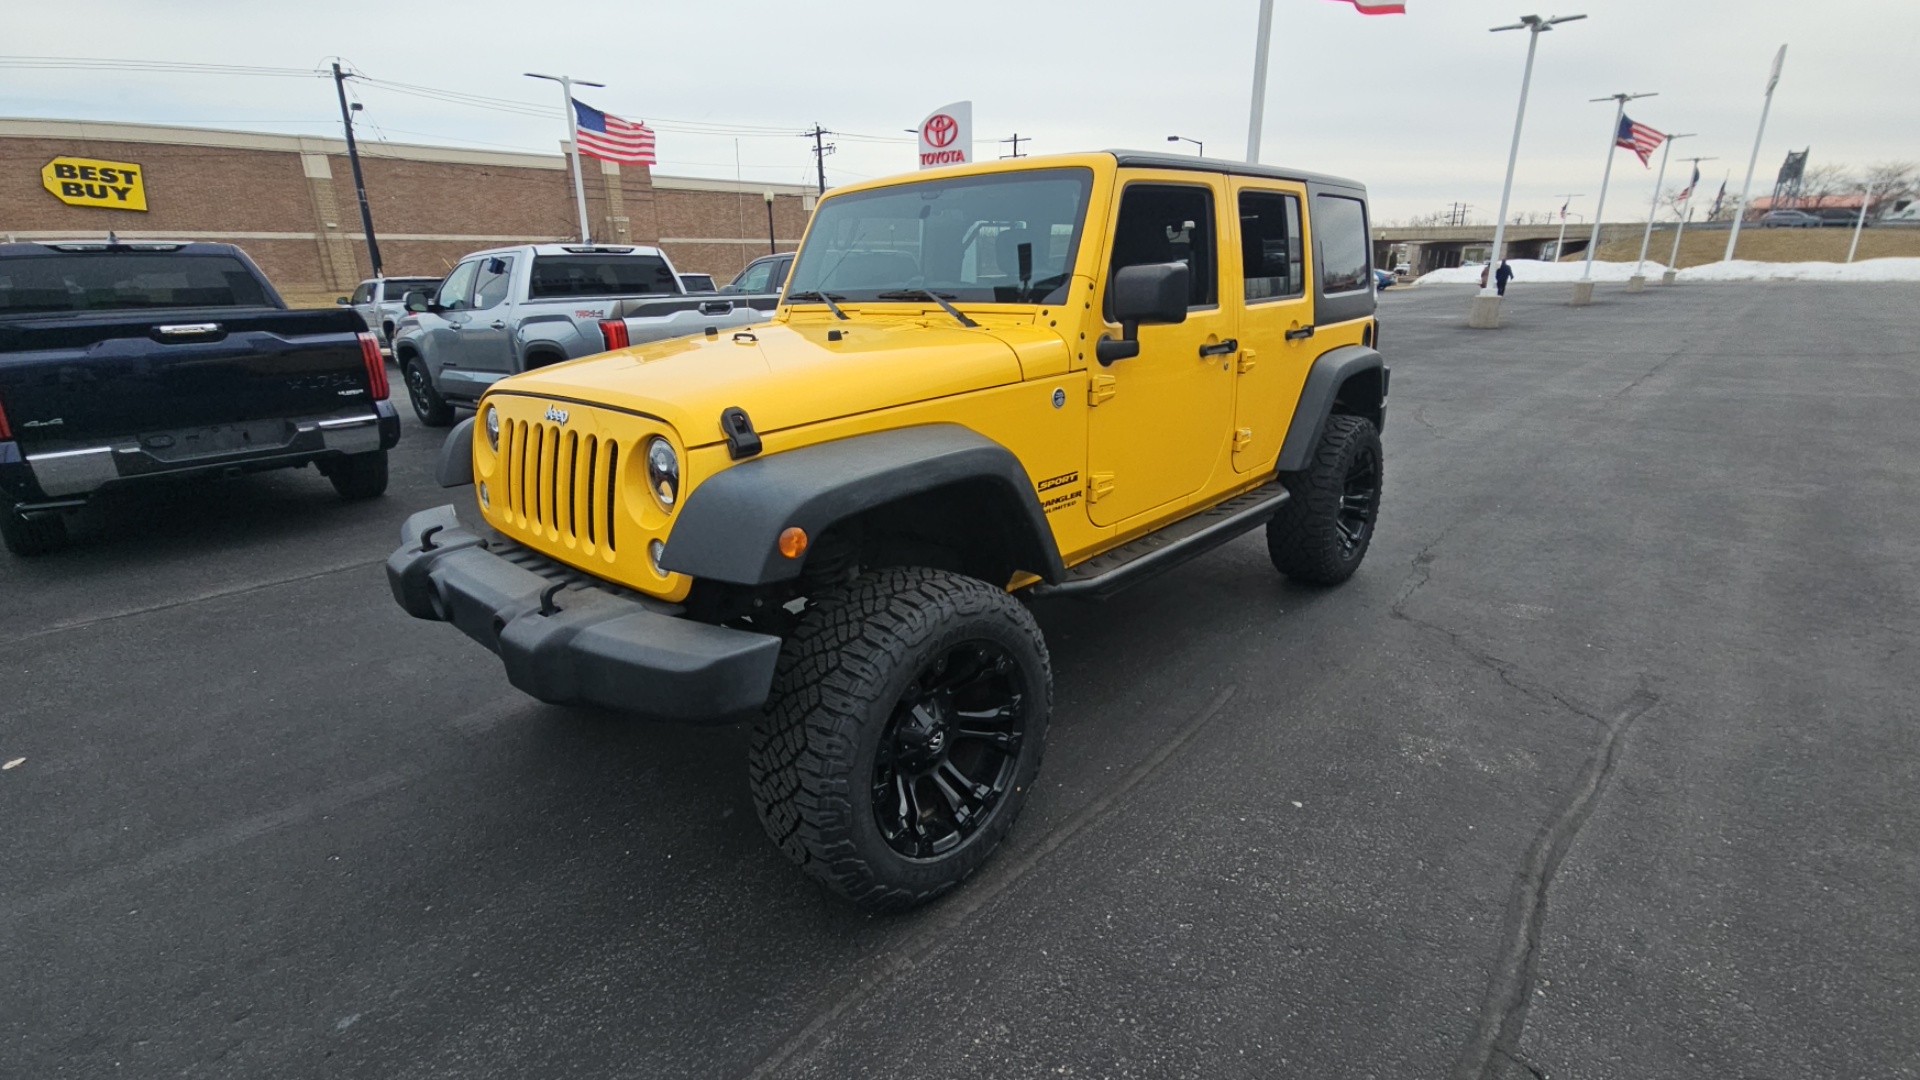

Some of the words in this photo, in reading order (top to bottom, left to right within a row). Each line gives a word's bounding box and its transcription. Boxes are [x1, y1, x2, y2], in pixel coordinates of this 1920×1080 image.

[920, 149, 965, 165] TOYOTA
[54, 163, 138, 185] BEST
[61, 181, 132, 201] BUY
[544, 403, 569, 426] Jeep
[1039, 474, 1077, 489] SPORT
